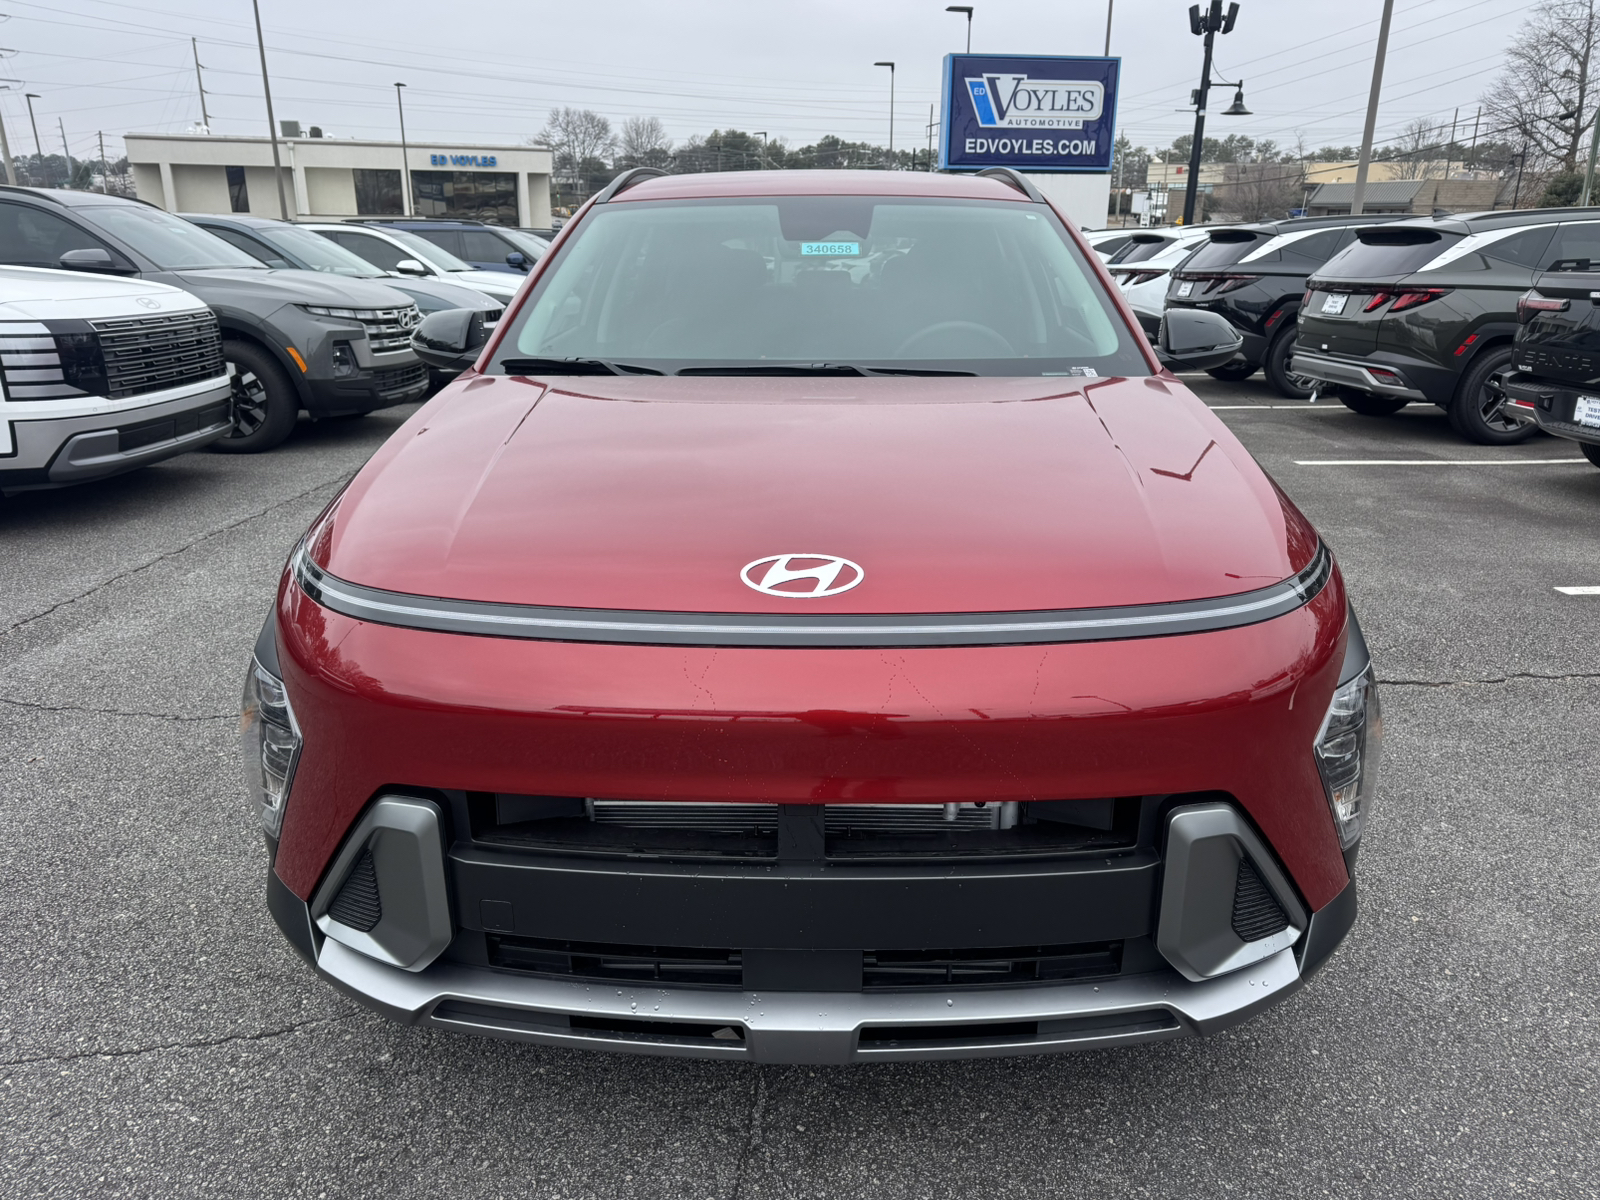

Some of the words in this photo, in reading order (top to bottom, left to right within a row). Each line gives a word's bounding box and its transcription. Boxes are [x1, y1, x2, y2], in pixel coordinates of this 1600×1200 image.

[973, 87, 985, 95] ED
[985, 76, 1095, 121] VOYLES
[1008, 119, 1081, 127] AUTOMOTIVE
[965, 138, 1096, 155] EDVOYLES.COM
[431, 154, 447, 165] ED
[450, 155, 497, 166] VOYLES
[806, 245, 852, 254] 340658
